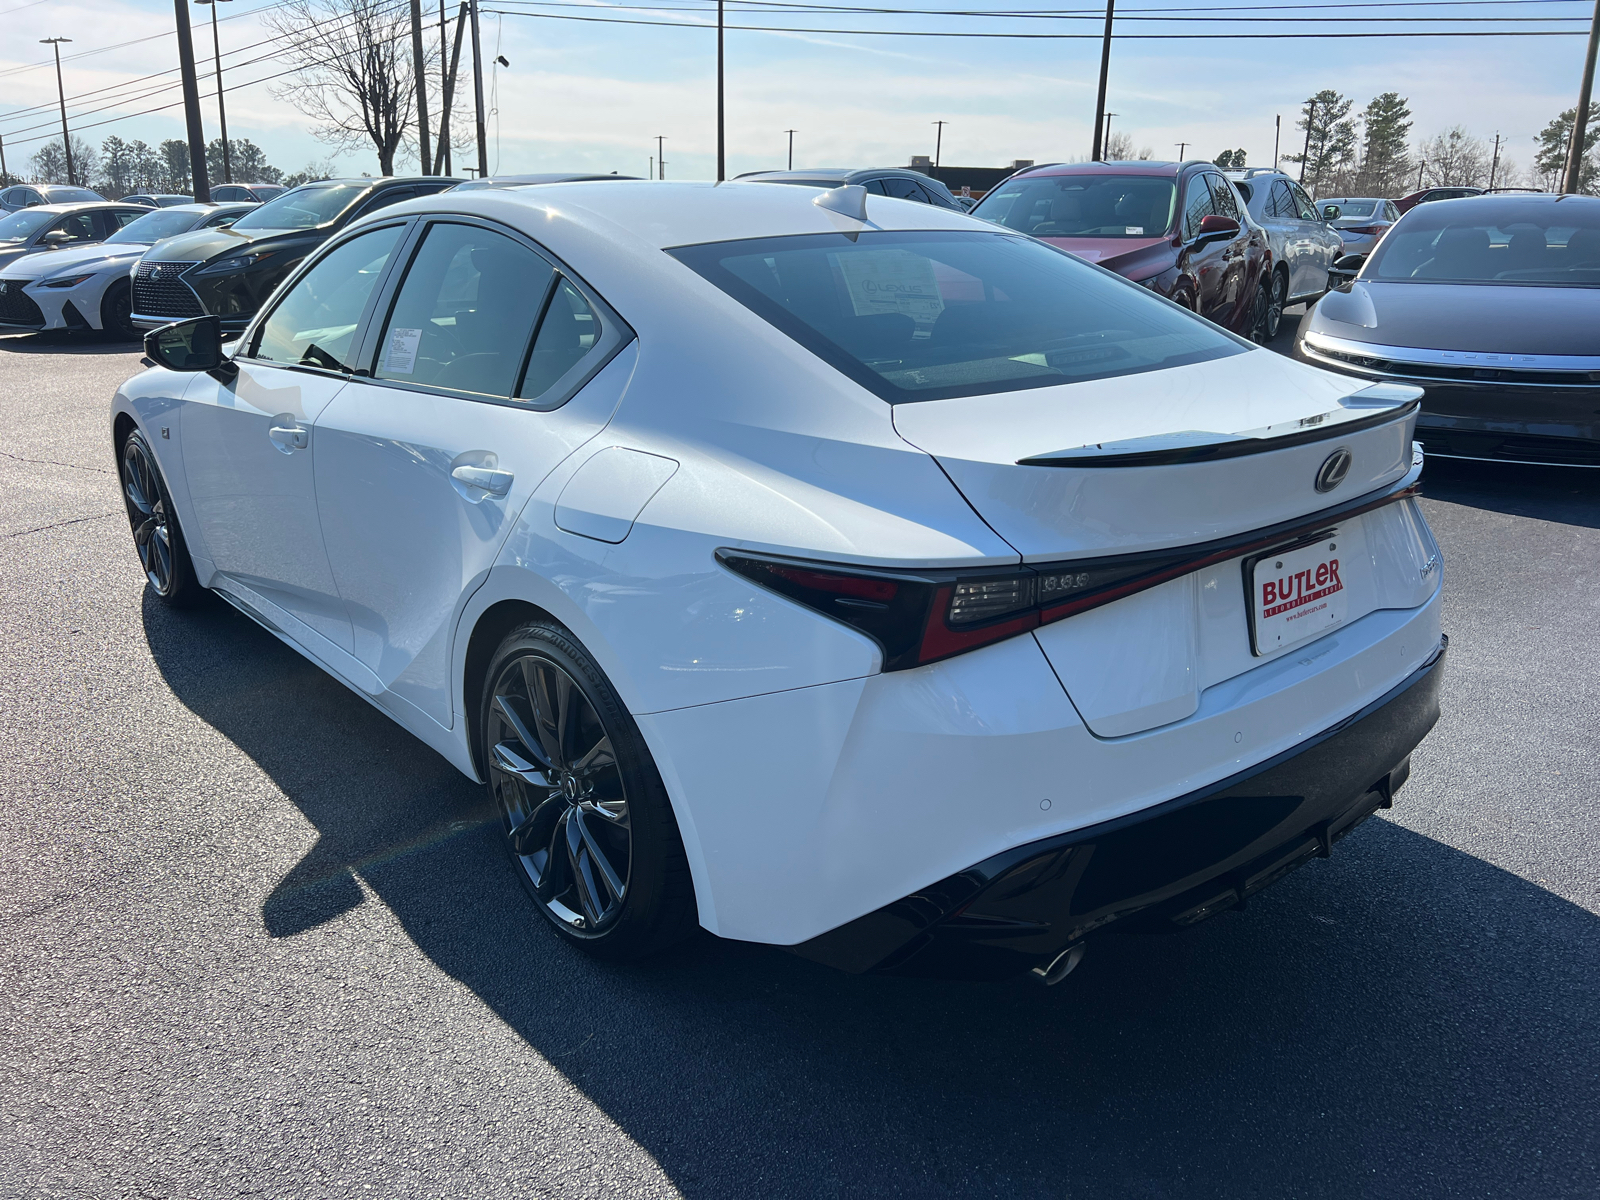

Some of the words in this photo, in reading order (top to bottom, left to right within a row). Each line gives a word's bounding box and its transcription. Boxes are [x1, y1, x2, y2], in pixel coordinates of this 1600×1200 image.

[879, 283, 922, 293] LEXUS
[1286, 603, 1327, 621] www.butlercars.com
[549, 634, 621, 725] BRIDGESTONE
